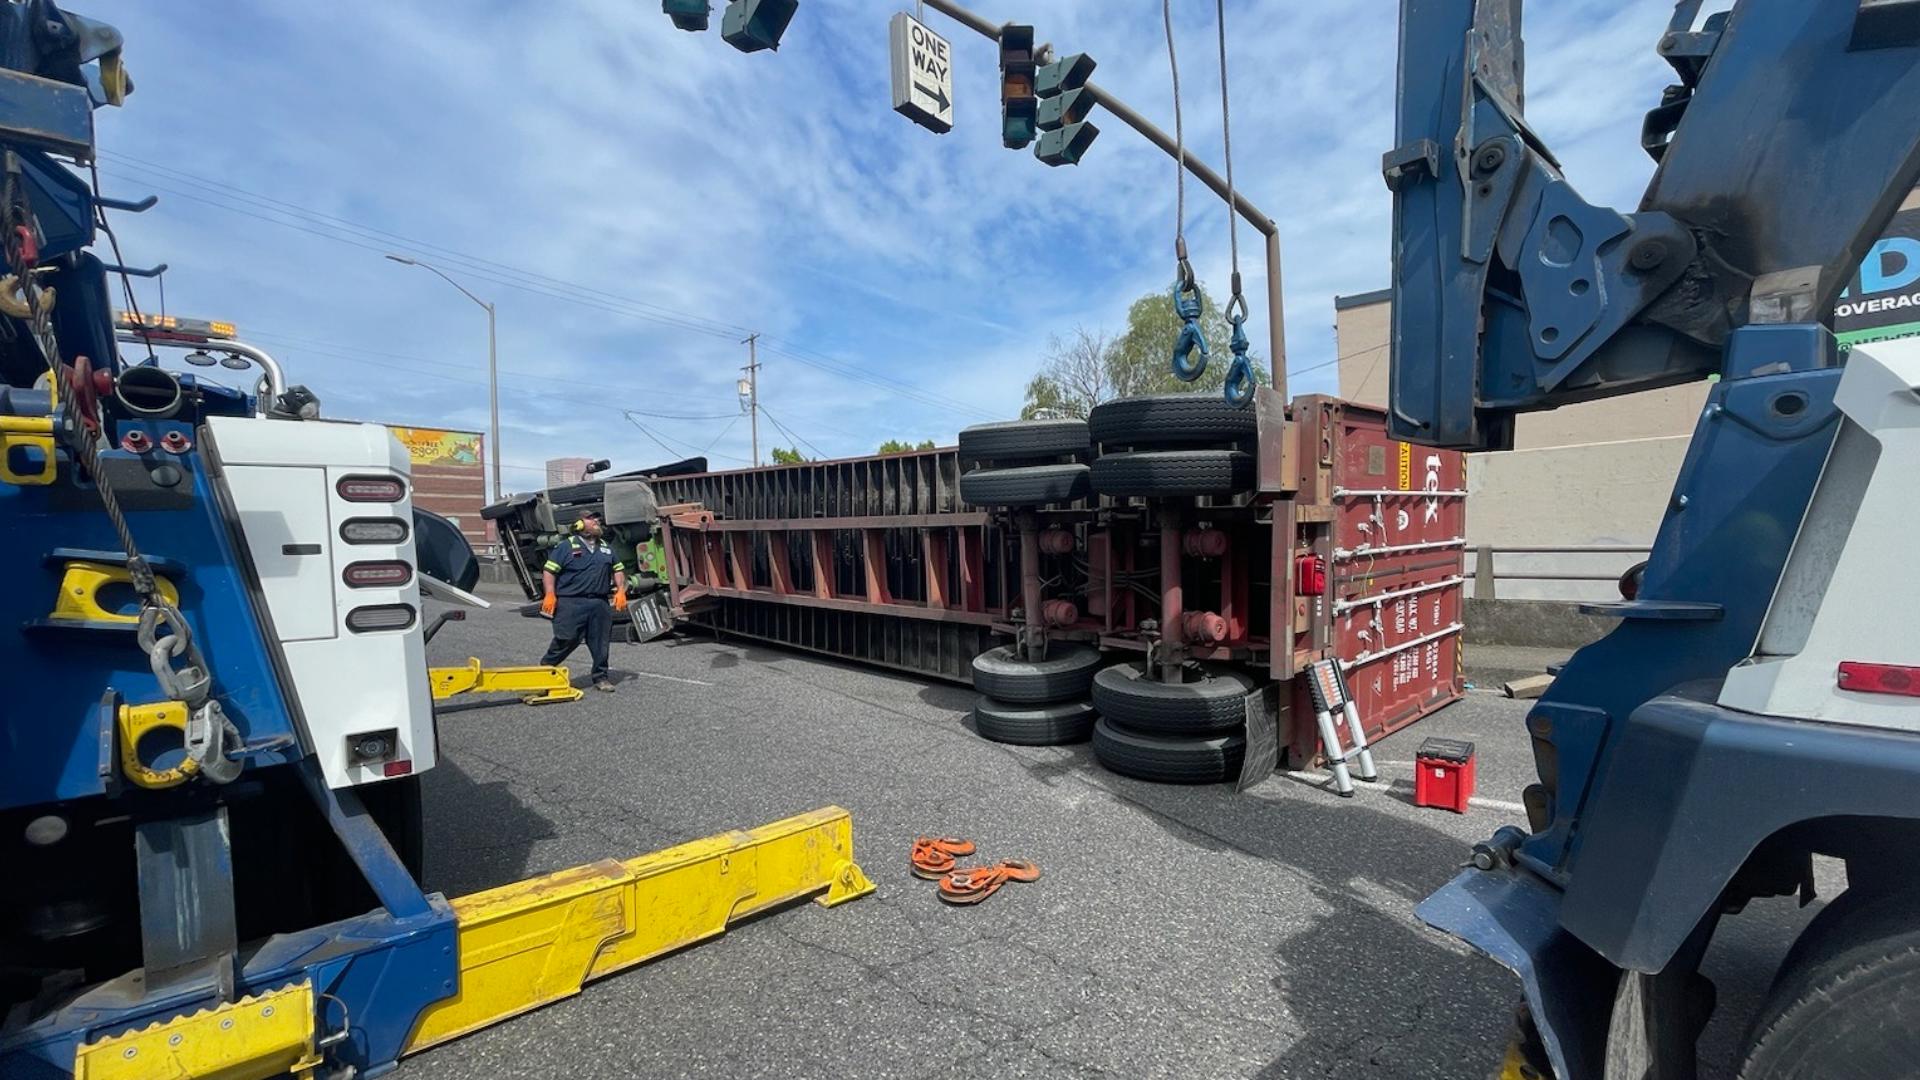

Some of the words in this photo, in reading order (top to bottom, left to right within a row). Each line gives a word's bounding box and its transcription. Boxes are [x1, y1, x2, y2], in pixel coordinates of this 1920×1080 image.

[912, 26, 947, 62] ONE
[912, 47, 947, 82] WAY
[1395, 598, 1406, 634] PAYLOAD
